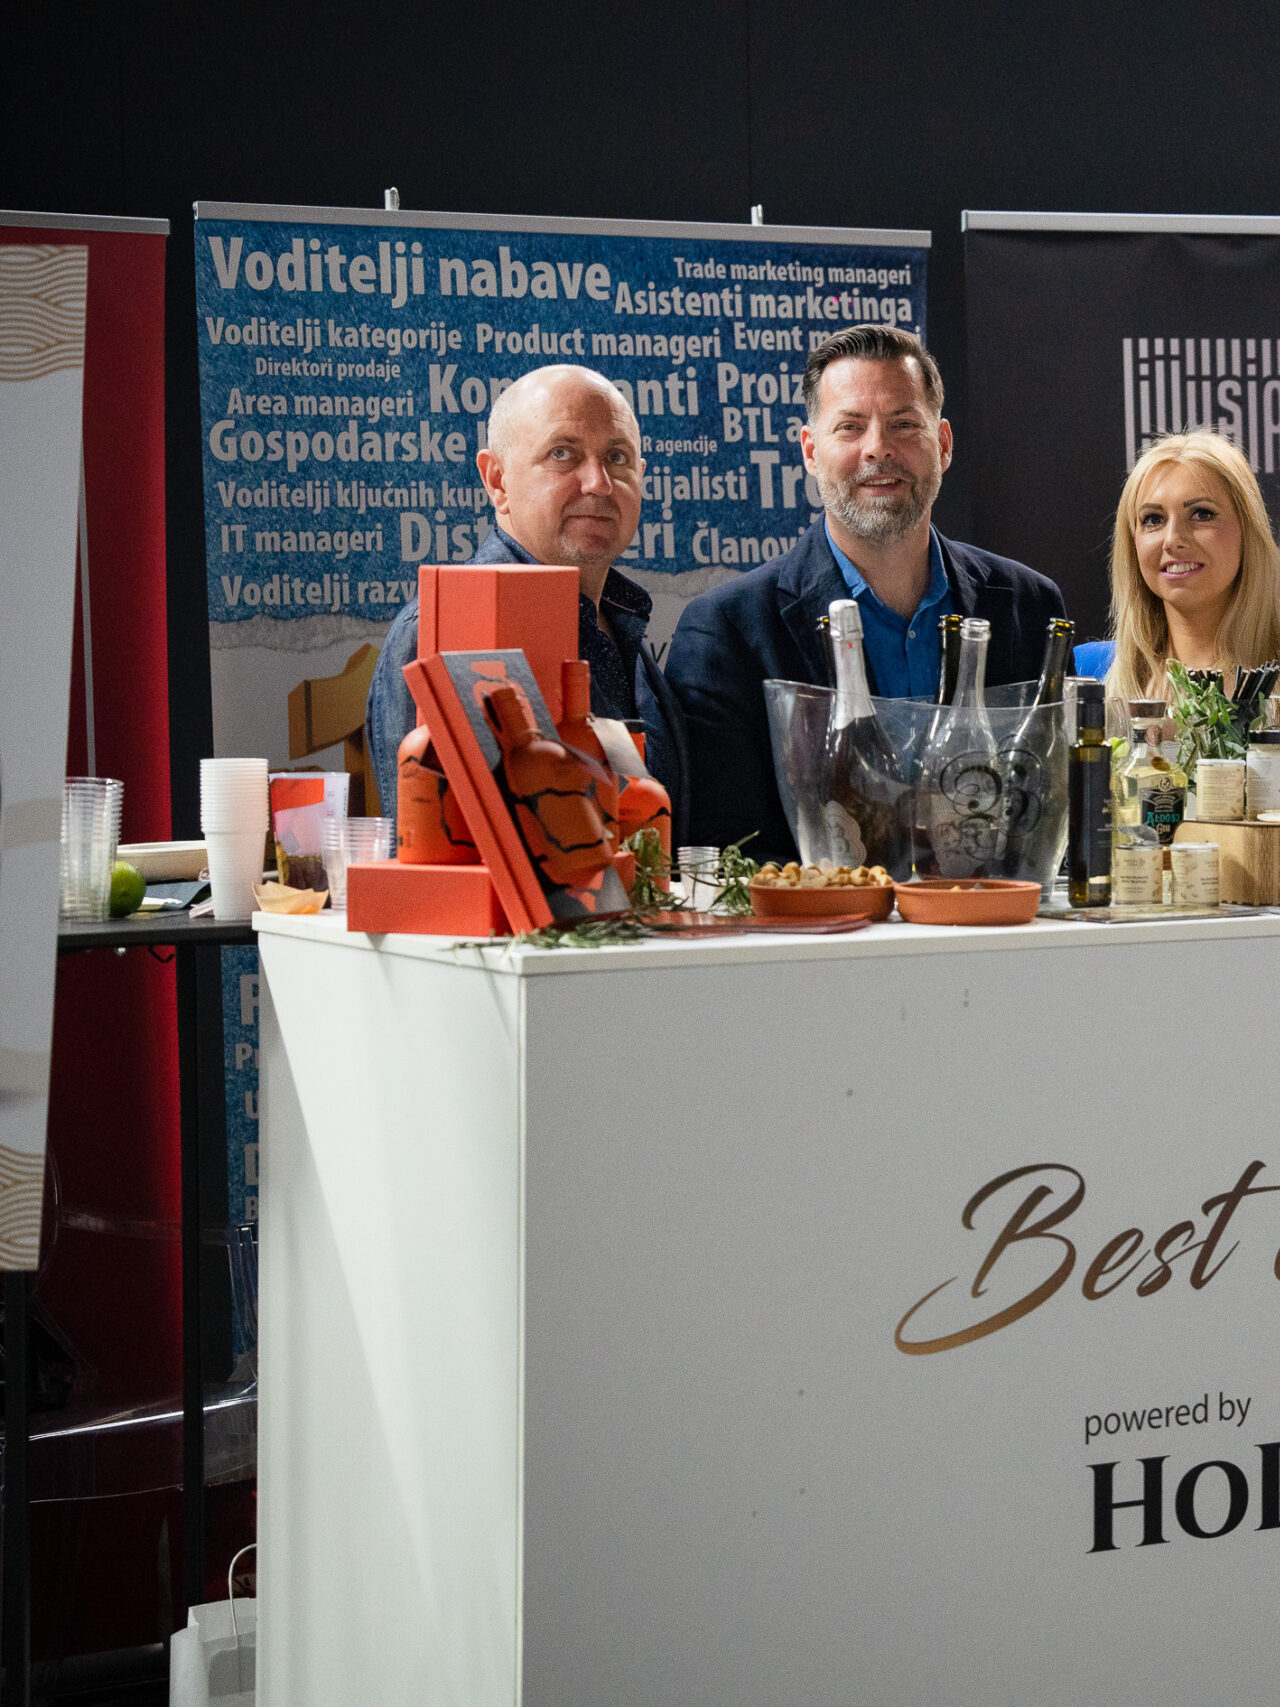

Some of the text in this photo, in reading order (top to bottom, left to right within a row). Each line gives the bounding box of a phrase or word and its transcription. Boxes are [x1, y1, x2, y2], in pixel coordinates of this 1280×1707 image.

[208, 236, 611, 308] Voditelji nabave
[674, 257, 912, 290] Trade marketing manageri
[615, 282, 912, 326] Asistenti marketinga
[205, 316, 721, 364] Voditelji kategorije Product manageri
[734, 322, 803, 351] Event
[256, 357, 401, 382] Direktori prodaje
[227, 388, 414, 425] Area manageri
[723, 407, 779, 443] BTL
[209, 419, 466, 472] Gospodarske
[656, 435, 717, 457] agencije
[217, 480, 493, 514] Voditelji ključnih kup
[641, 466, 748, 508] cijalisti
[221, 522, 383, 559] IT manageri
[221, 574, 419, 612] Voditelji razv
[1084, 1391, 1252, 1445] powered by
